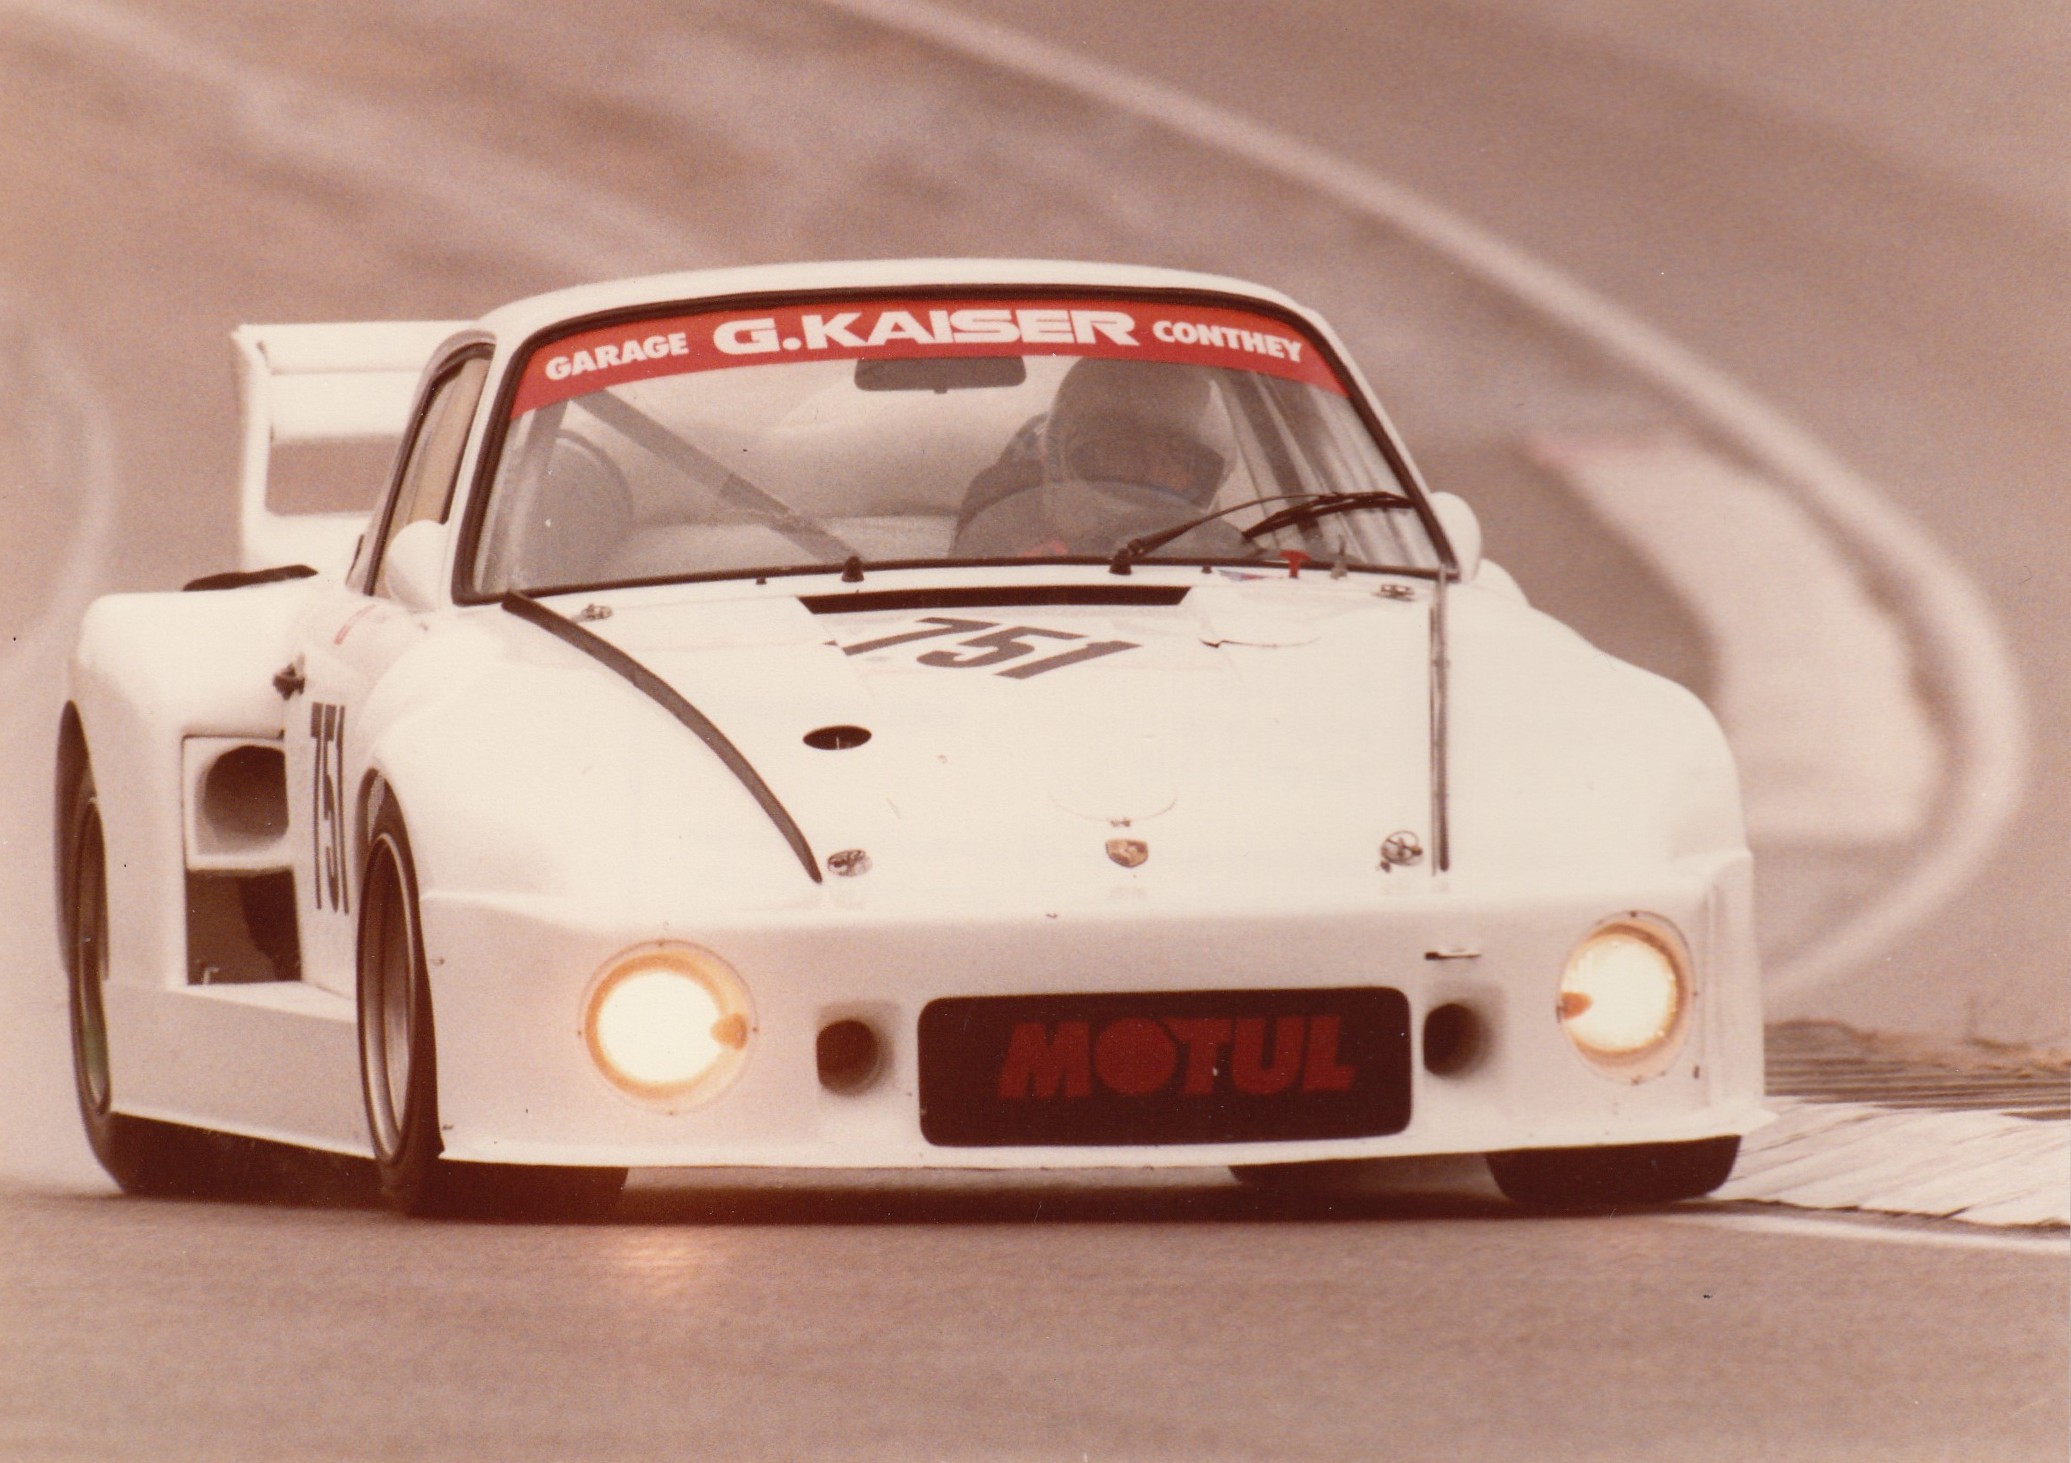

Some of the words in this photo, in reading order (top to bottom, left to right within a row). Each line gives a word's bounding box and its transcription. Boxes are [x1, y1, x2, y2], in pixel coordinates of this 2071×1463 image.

[545, 332, 690, 380] GARAGE
[712, 310, 1139, 355] G.KAISER
[1152, 321, 1302, 362] CONTHEY
[822, 616, 1142, 679] 751
[310, 701, 350, 915] 751
[997, 1015, 1357, 1101] MOTUL
